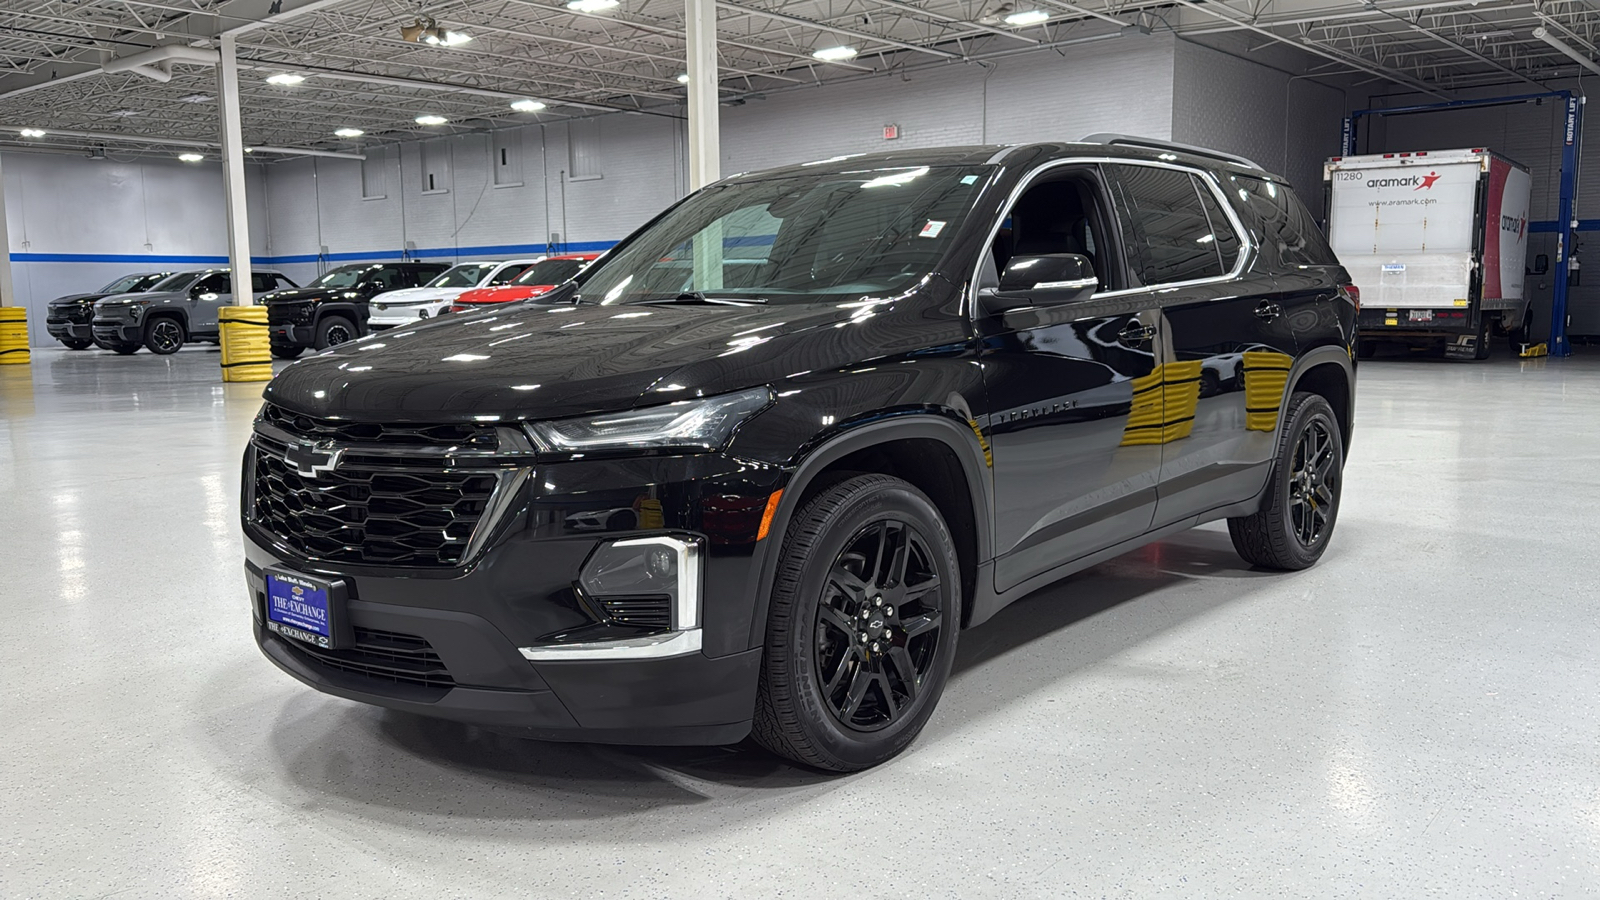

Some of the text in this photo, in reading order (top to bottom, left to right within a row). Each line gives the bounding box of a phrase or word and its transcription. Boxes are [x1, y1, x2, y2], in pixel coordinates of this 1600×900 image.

[1567, 113, 1575, 141] ROTARY
[1336, 172, 1363, 181] 11280
[1367, 175, 1420, 188] aramark
[1368, 198, 1437, 207] www.aramark.com
[1502, 214, 1520, 234] aramark
[273, 596, 326, 621] THE EXCHANGE
[268, 621, 316, 644] THE EXCHANGE
